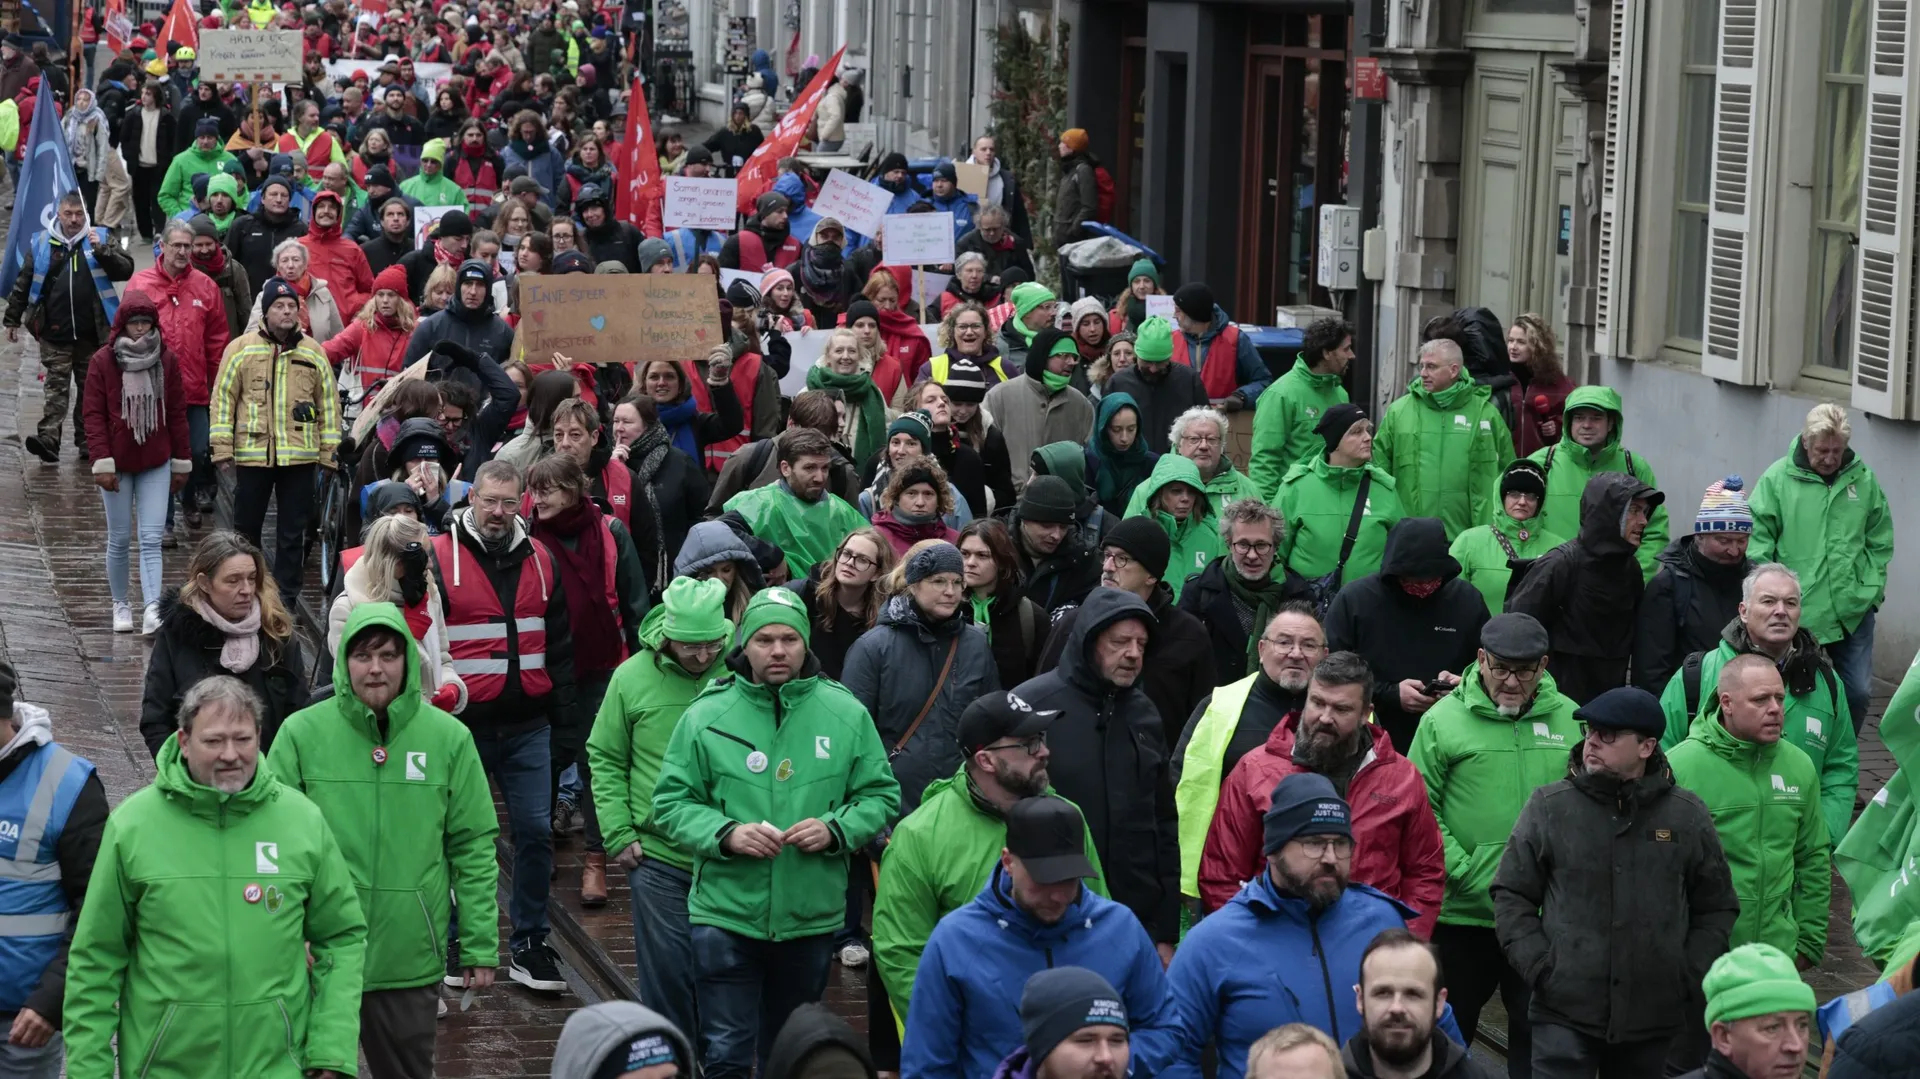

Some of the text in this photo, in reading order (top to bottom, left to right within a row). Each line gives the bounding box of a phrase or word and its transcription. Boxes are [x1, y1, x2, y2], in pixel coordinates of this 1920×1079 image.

[1550, 733, 1565, 741] ACV
[1088, 1008, 1108, 1016] JUST
[628, 1048, 650, 1062] JUST
